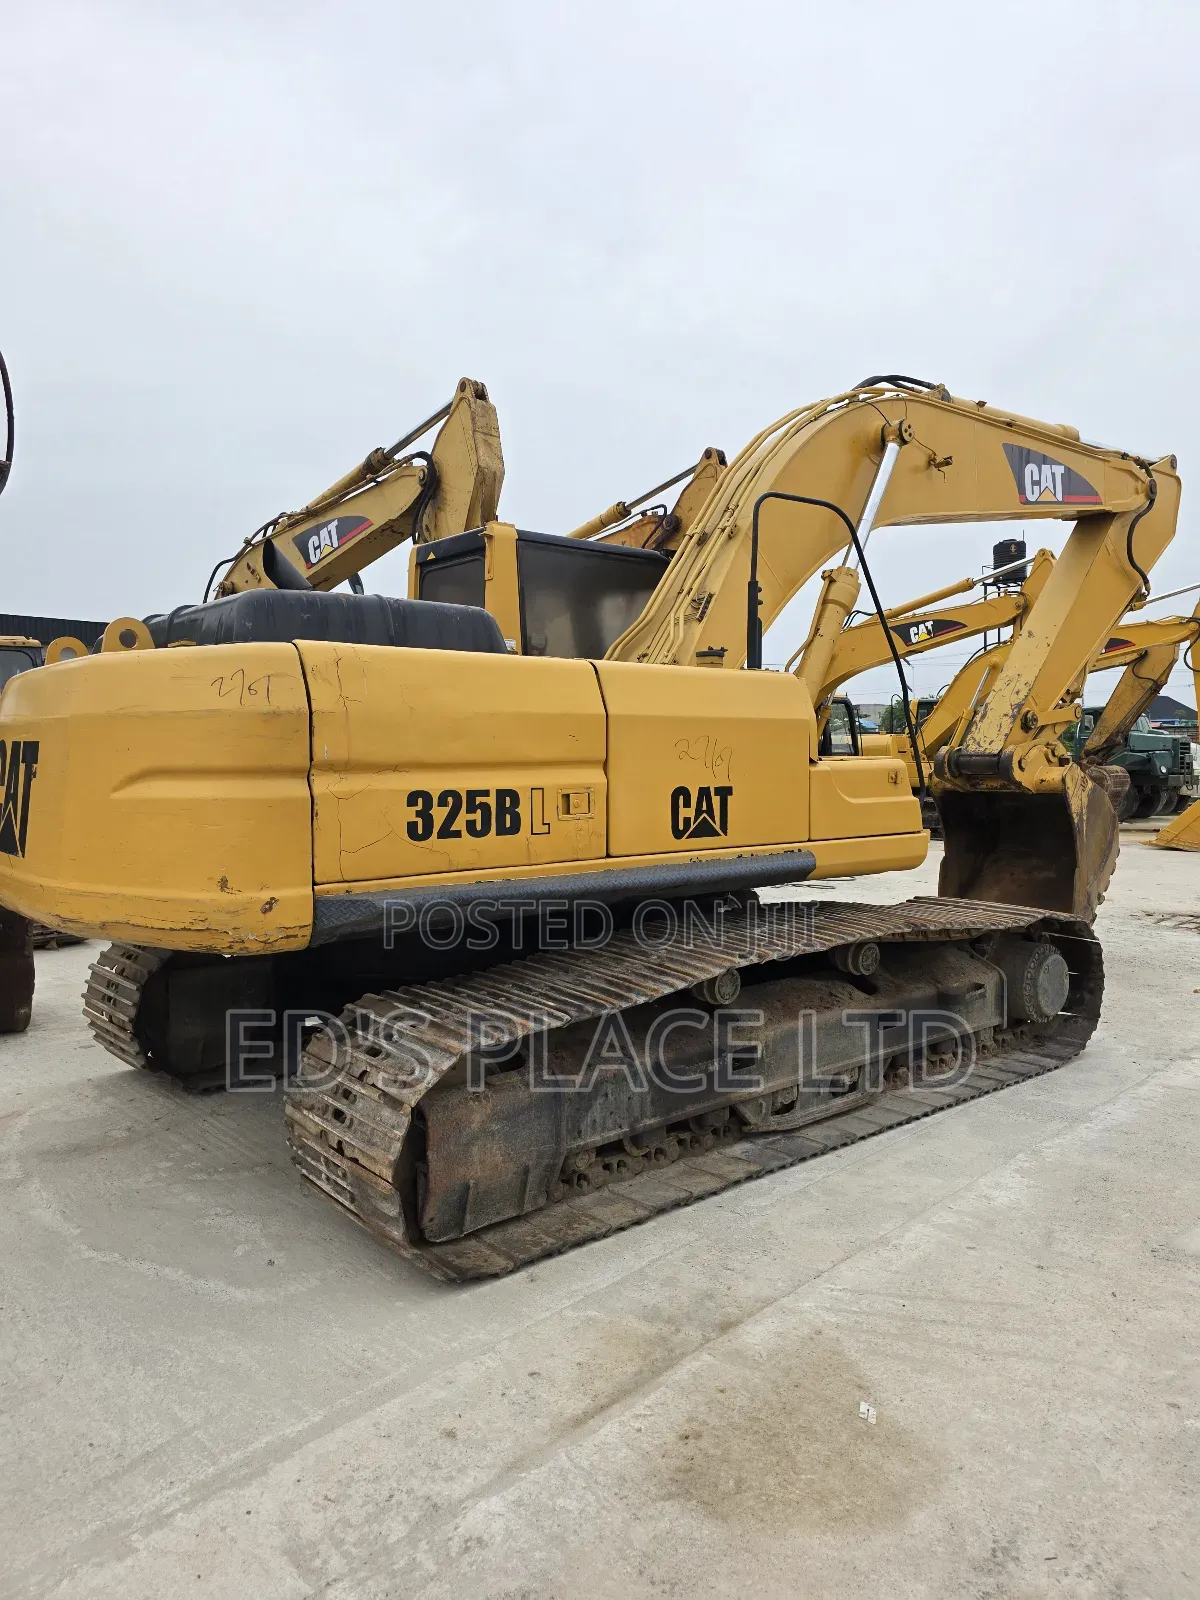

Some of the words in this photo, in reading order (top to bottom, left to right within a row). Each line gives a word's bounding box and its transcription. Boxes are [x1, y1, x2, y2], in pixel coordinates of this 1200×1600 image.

[1024, 463, 1065, 502] CAT
[307, 519, 339, 564] CAT
[909, 620, 934, 644] CAT
[406, 789, 522, 842] 325B
[530, 787, 551, 836] L
[670, 785, 734, 840] CAT
